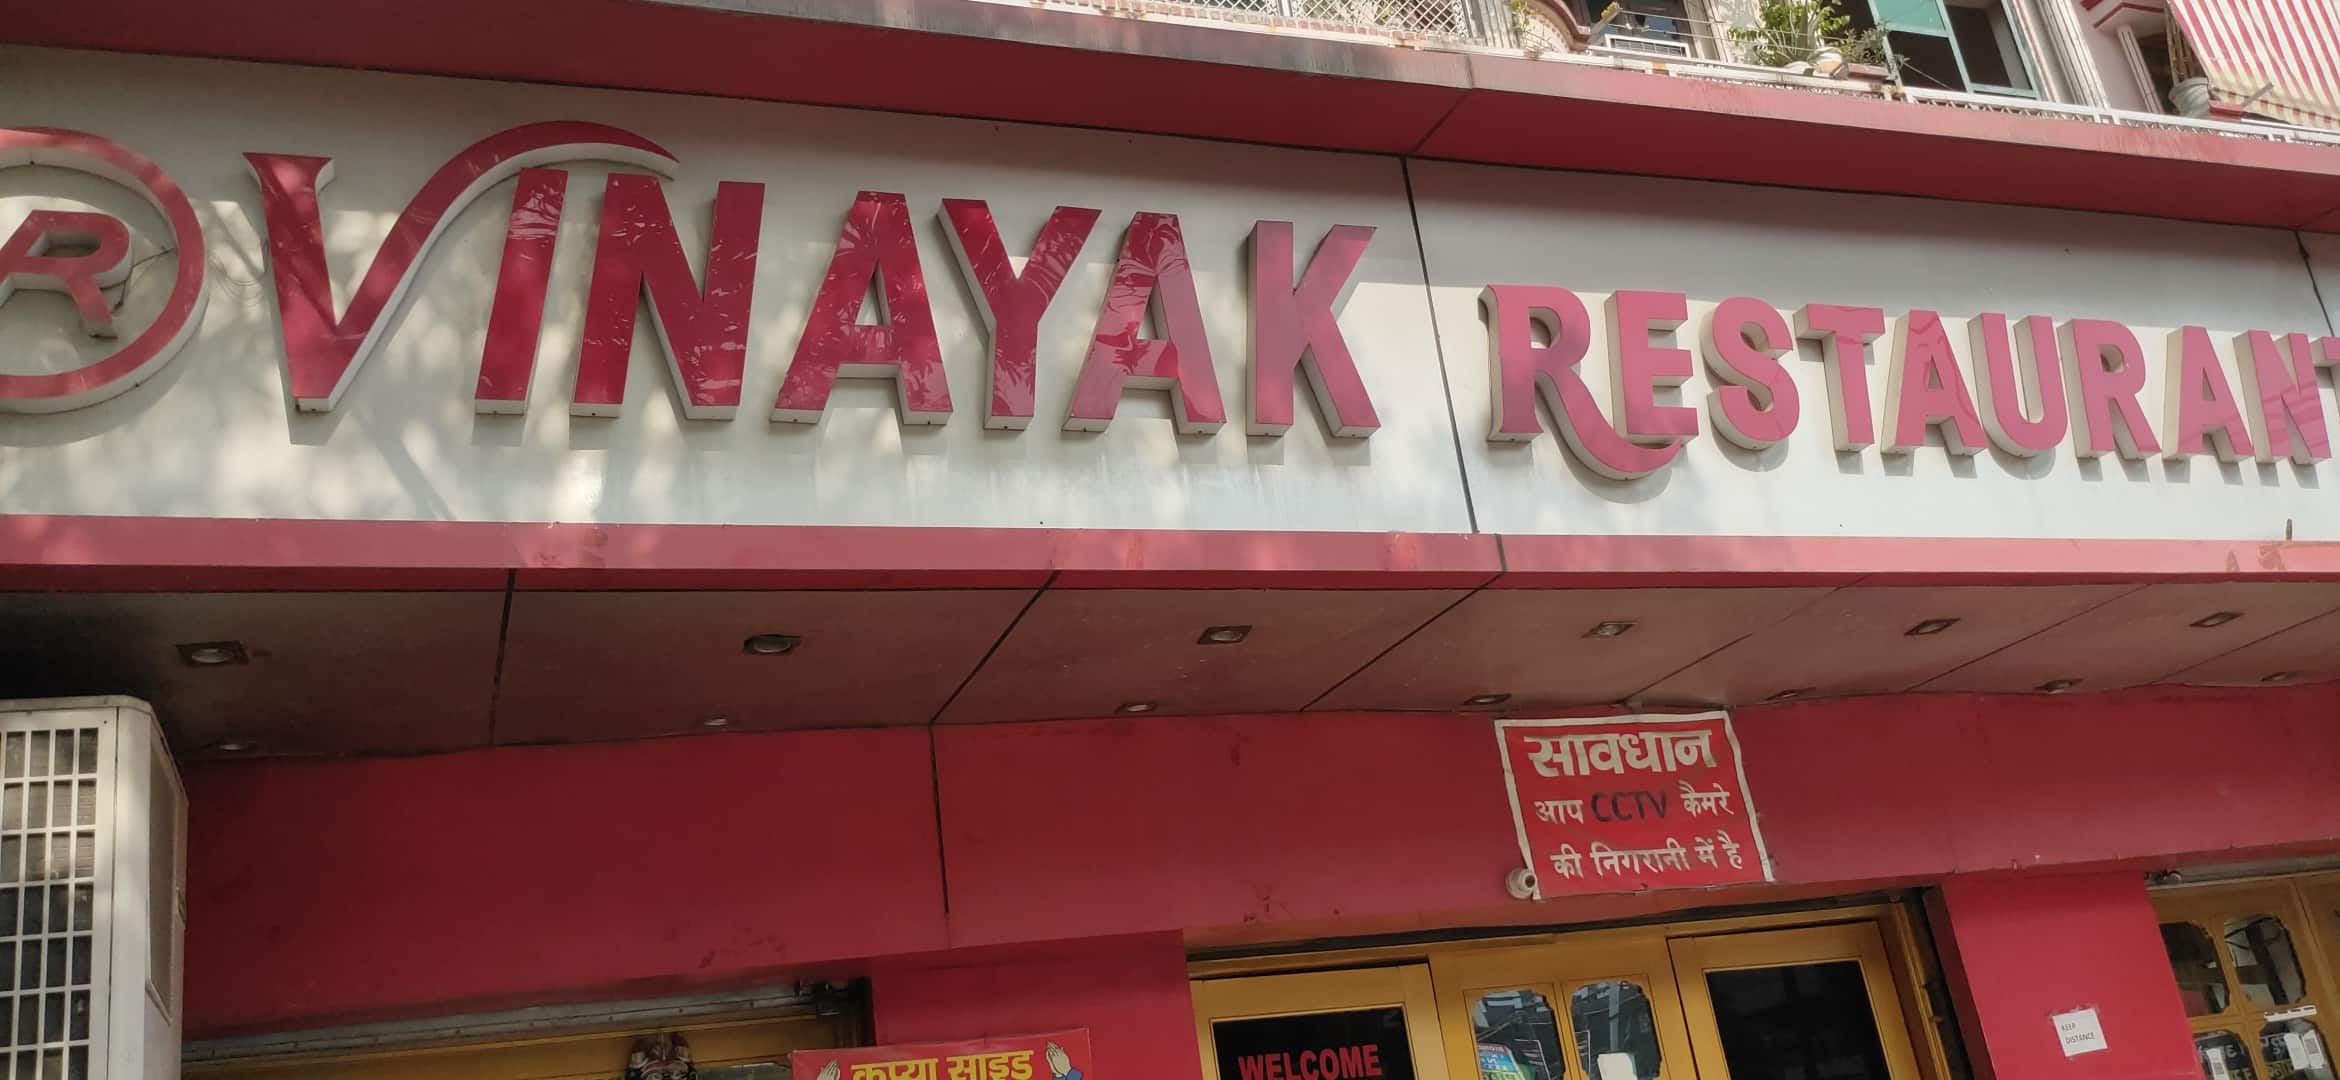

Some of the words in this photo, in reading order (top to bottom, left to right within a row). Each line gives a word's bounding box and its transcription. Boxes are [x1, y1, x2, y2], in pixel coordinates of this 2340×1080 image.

[242, 120, 1381, 438] VINAYAK
[1524, 730, 1718, 777] सावधान
[1534, 800, 1584, 825] आप
[1591, 791, 1667, 822] CCTV
[1679, 780, 1735, 817] कैमरे
[1551, 843, 1584, 879] की
[1590, 837, 1691, 878] निगरानी
[1695, 835, 1719, 868] में
[1717, 829, 1743, 869] है
[2065, 1032, 2096, 1044] DISTANCE
[1238, 1044, 1383, 1080] WELCOME
